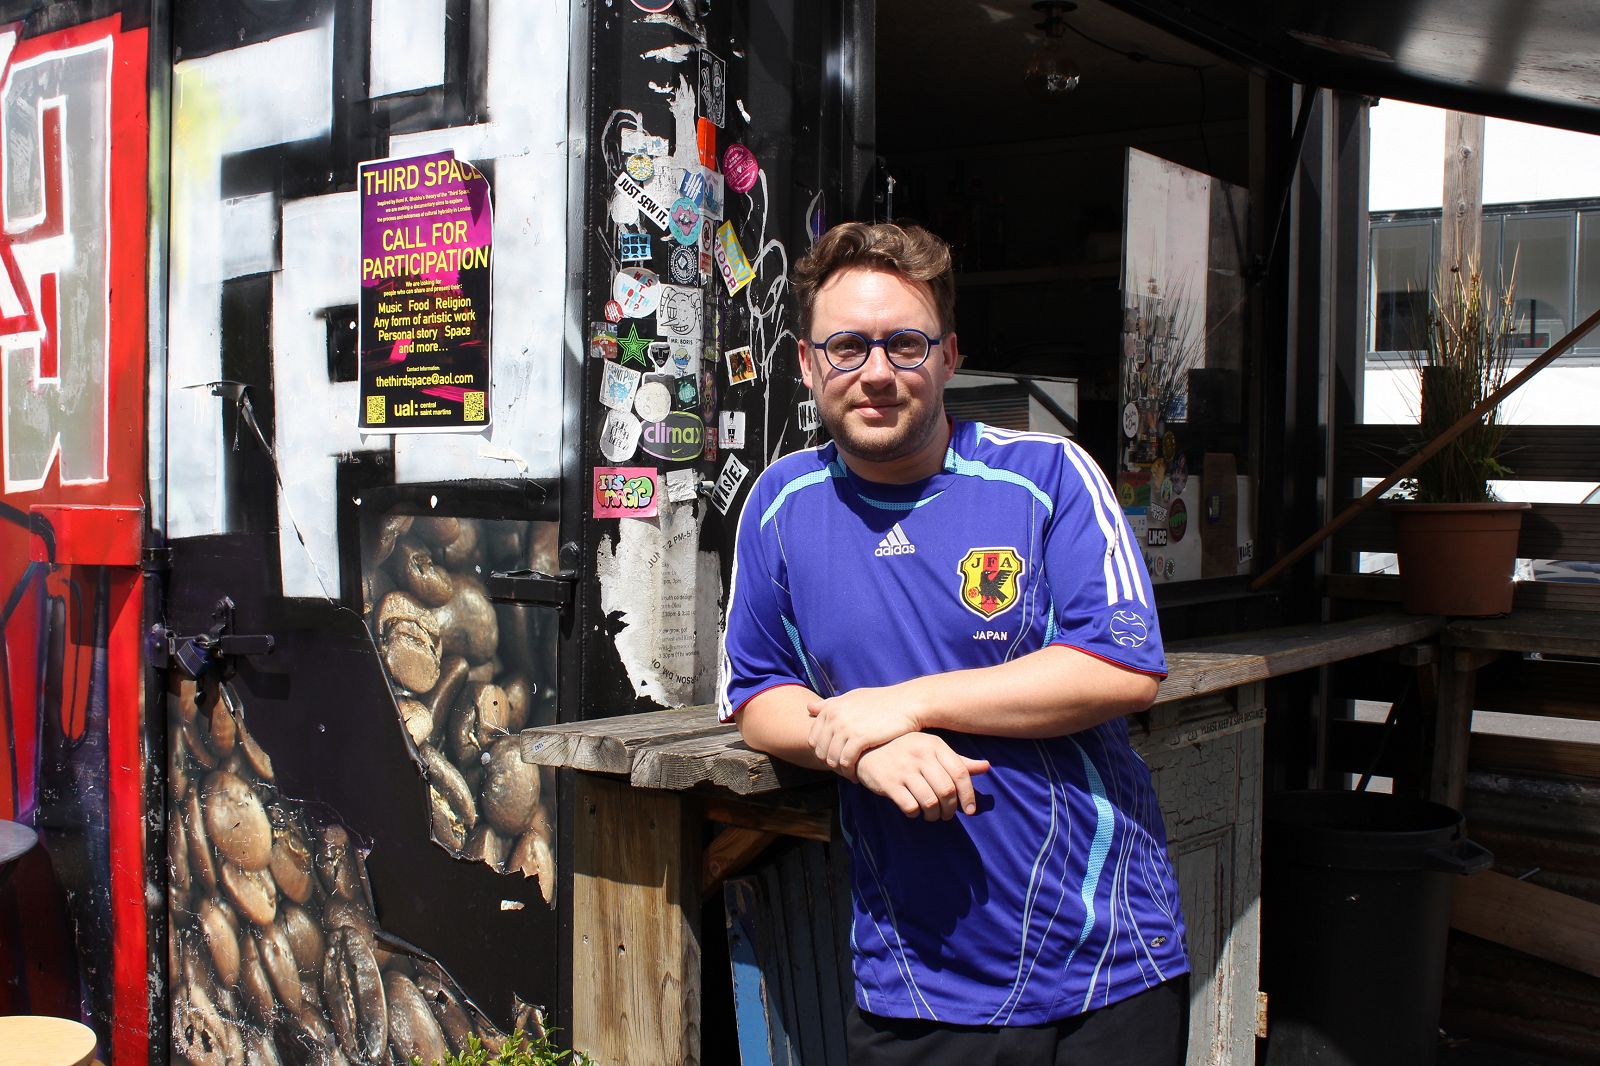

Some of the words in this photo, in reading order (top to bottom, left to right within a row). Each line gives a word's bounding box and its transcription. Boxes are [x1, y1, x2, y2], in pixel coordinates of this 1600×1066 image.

[363, 164, 419, 195] THIRD
[618, 177, 641, 200] JUST
[637, 191, 658, 214] SEW
[655, 206, 668, 225] IT.
[382, 225, 427, 252] CALL
[432, 220, 468, 246] FOR
[363, 245, 489, 281] PARTICIPATION
[378, 302, 403, 314] Music
[408, 299, 430, 312] Food
[435, 296, 471, 311] Religion
[373, 316, 390, 331] Any
[391, 315, 411, 327] form
[412, 313, 422, 325] of
[422, 311, 453, 325] artistic
[453, 309, 476, 322] work
[378, 328, 415, 341] Personal
[416, 327, 438, 341] story
[444, 325, 471, 339] Space
[398, 341, 415, 354] and
[376, 372, 474, 388] thethirdspace@aol.com
[394, 399, 419, 417] ual:
[420, 401, 437, 409] central
[432, 408, 452, 416] martins
[643, 421, 701, 444] climax
[712, 459, 742, 511] WASTE!
[604, 487, 651, 509] MAGIC
[874, 543, 916, 557] adidas
[970, 556, 1013, 570] JFA
[972, 630, 1008, 641] JAPAN
